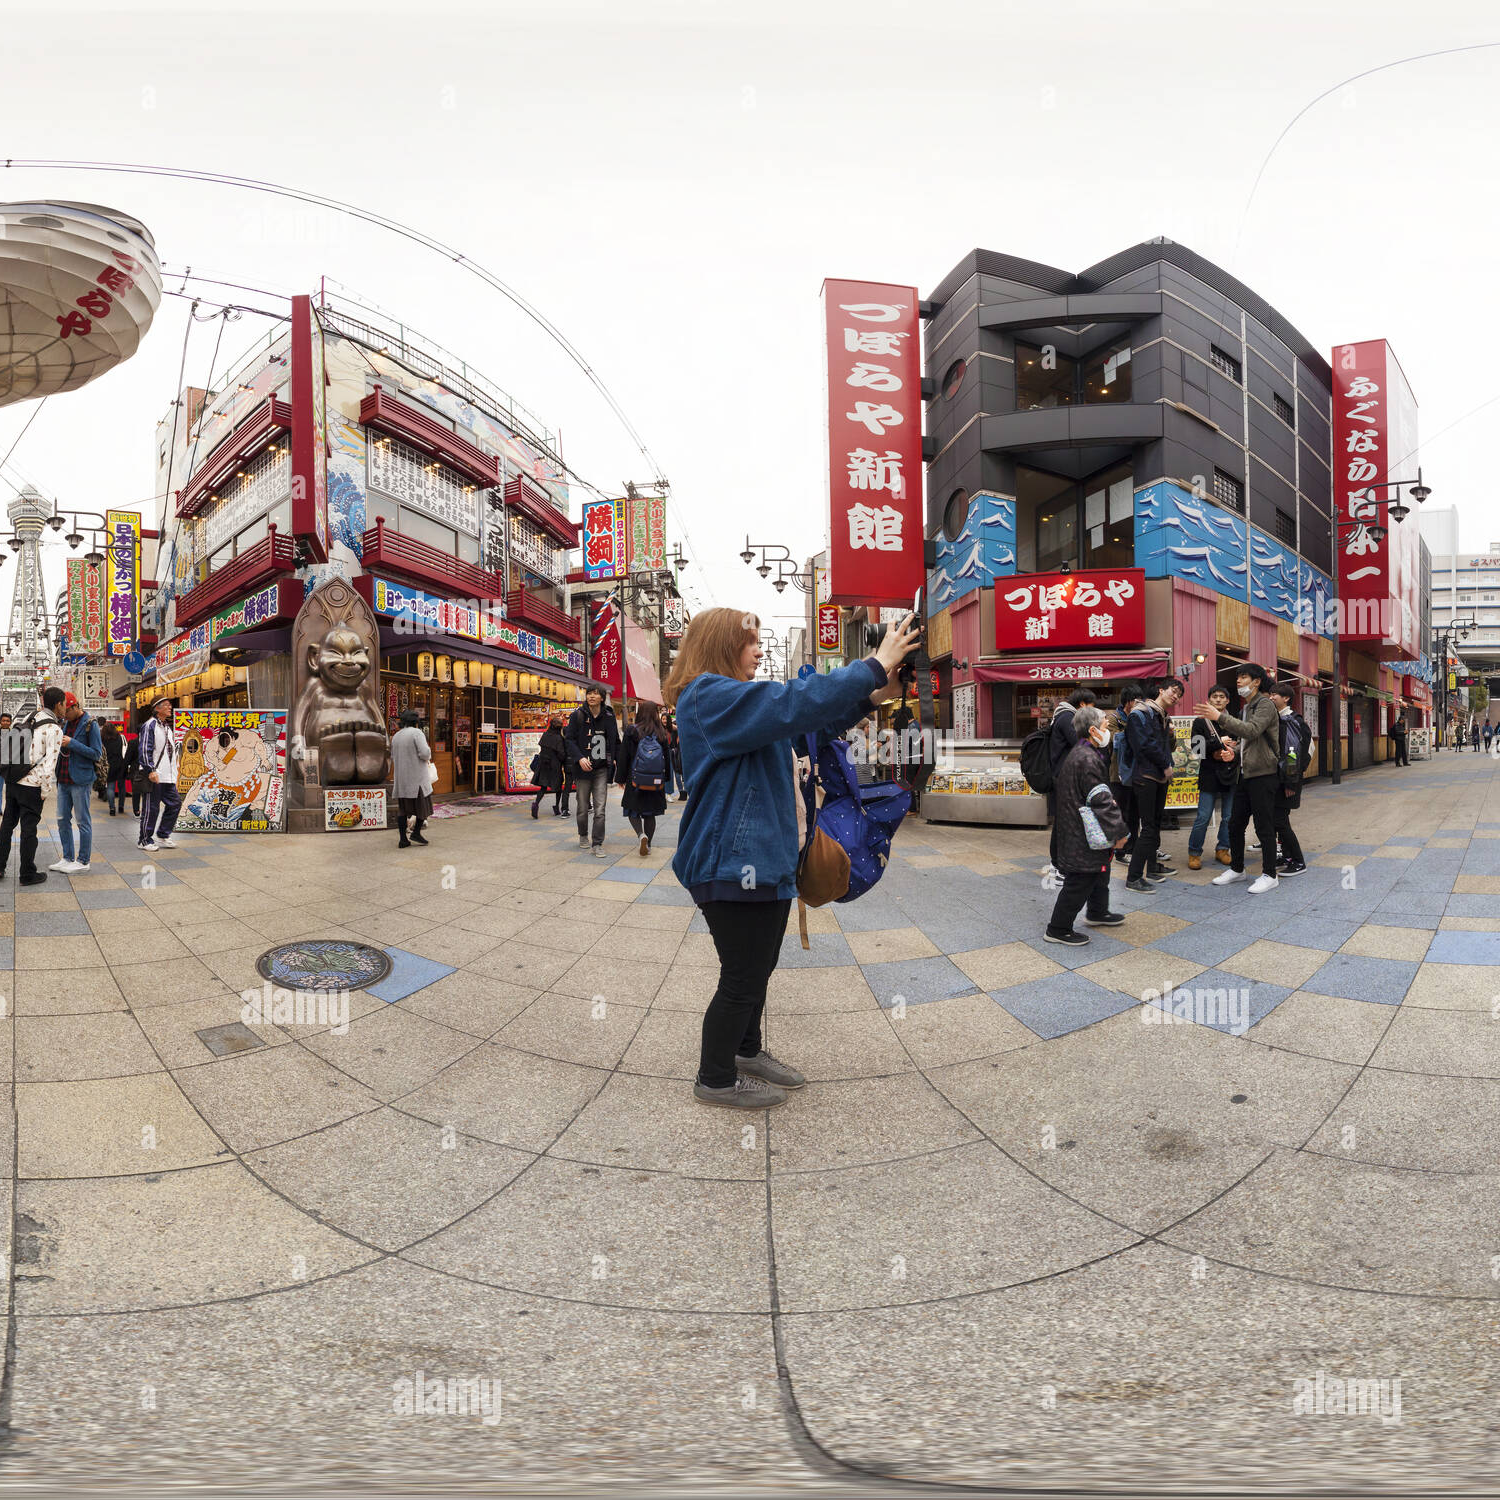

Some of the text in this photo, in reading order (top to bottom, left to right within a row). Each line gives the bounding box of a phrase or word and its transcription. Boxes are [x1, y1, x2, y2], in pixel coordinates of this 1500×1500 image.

[839, 302, 908, 552] づぼらや新館
[1343, 376, 1382, 582] ふぐなら日本一
[586, 504, 614, 566] 横綱
[616, 520, 626, 576] 日本一の串かつ
[244, 590, 270, 628] 横綱
[1004, 578, 1136, 612] づぼらや
[109, 592, 138, 641] 横綱
[437, 598, 470, 634] 横綱
[819, 611, 838, 644] 王将
[1024, 611, 1115, 641] 新館
[517, 629, 537, 657] 横綱
[609, 637, 618, 666] サンパツ
[1027, 664, 1104, 679] づぼらや新館
[175, 712, 262, 729] 大阪新世界
[362, 818, 377, 828] 300
